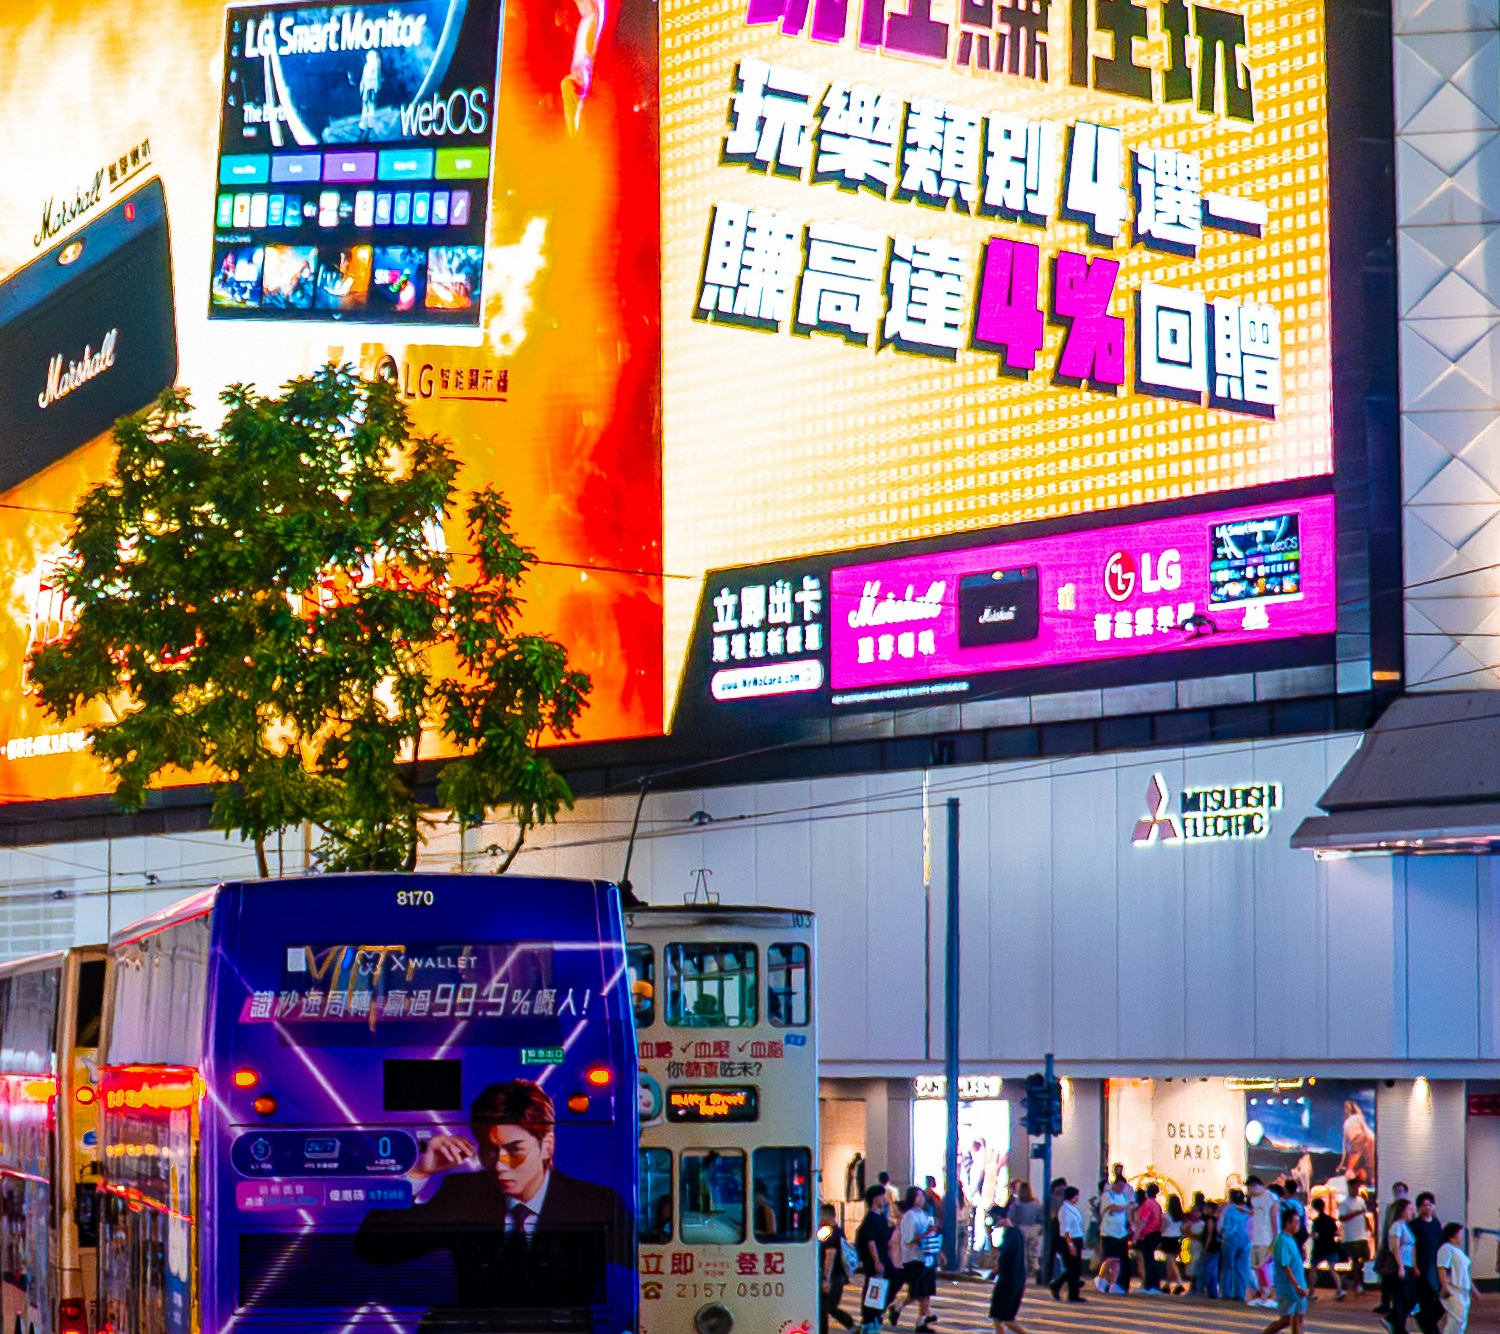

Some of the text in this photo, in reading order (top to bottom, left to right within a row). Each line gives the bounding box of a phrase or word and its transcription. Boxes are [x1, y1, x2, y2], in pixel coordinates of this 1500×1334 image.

[279, 14, 340, 55] Smart
[342, 9, 426, 49] Monitor
[718, 57, 1268, 259] 玩樂類別4選一
[33, 167, 104, 247] Marshall
[693, 201, 1281, 419] 賺高達4%回贈
[38, 328, 118, 408] Marshall
[404, 364, 433, 399] LG
[1141, 549, 1182, 593] LG
[713, 575, 822, 632] 立即出卡
[397, 891, 433, 905] 8170
[409, 956, 477, 969] WALLET
[694, 1041, 730, 1057] 血壓
[1167, 1122, 1226, 1139] DELSEY
[1174, 1144, 1221, 1159] PARIS
[641, 1253, 694, 1275] 立即
[736, 1252, 785, 1275] 登記
[676, 1283, 784, 1297] 2157 0500
